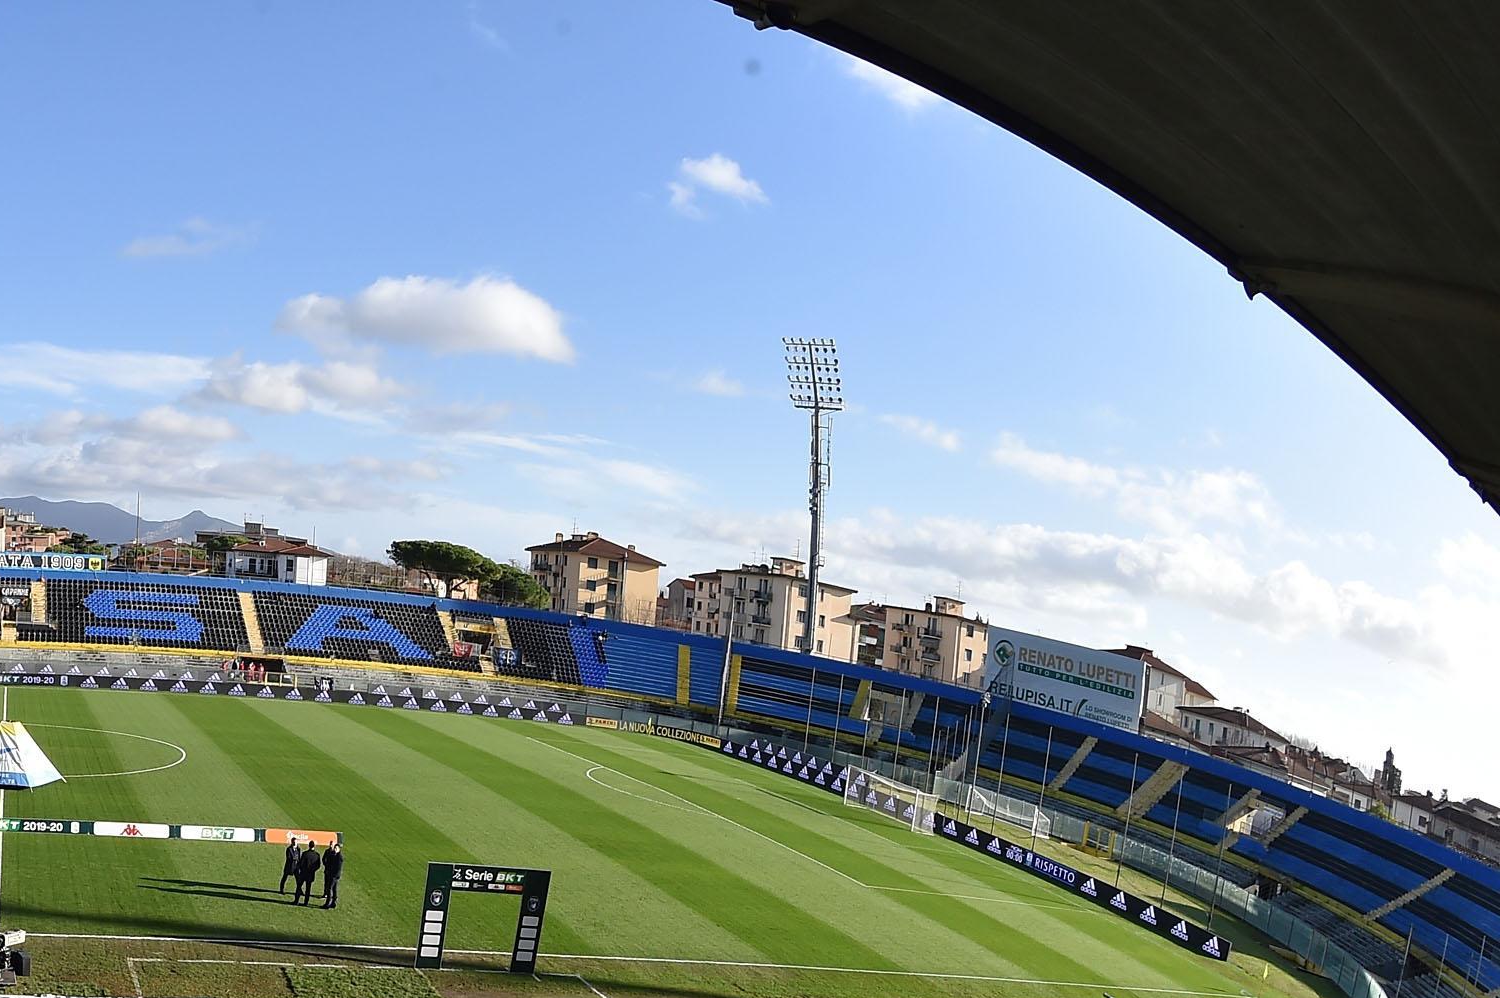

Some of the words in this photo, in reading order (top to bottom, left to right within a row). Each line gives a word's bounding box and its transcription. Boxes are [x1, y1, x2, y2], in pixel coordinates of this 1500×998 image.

[40, 554, 85, 570] 1909
[1018, 647, 1074, 673] RENATO
[1078, 660, 1136, 689] LUPETTI
[22, 676, 54, 684] 2019-20
[1018, 664, 1050, 677] TUTTO
[1056, 672, 1074, 684] PER
[1078, 678, 1134, 699] L'EDILIZIA
[619, 721, 628, 730] LA
[629, 722, 655, 735] NUOVA
[656, 726, 700, 743] COLLEZIONE
[23, 822, 64, 832] 2019-20
[943, 828, 957, 836] adidas
[200, 828, 235, 840] BKT
[965, 836, 979, 845] adidas
[987, 845, 1001, 854] adidas
[1006, 850, 1023, 863] 00:00
[465, 869, 493, 881] Serie
[496, 872, 524, 883] BKT
[1035, 857, 1075, 883] RISPETTO
[1080, 886, 1097, 896] adidas
[1110, 899, 1127, 911] adidas
[1140, 913, 1157, 926] adidas
[1170, 927, 1188, 941] adidas
[1202, 944, 1220, 958] adidas
